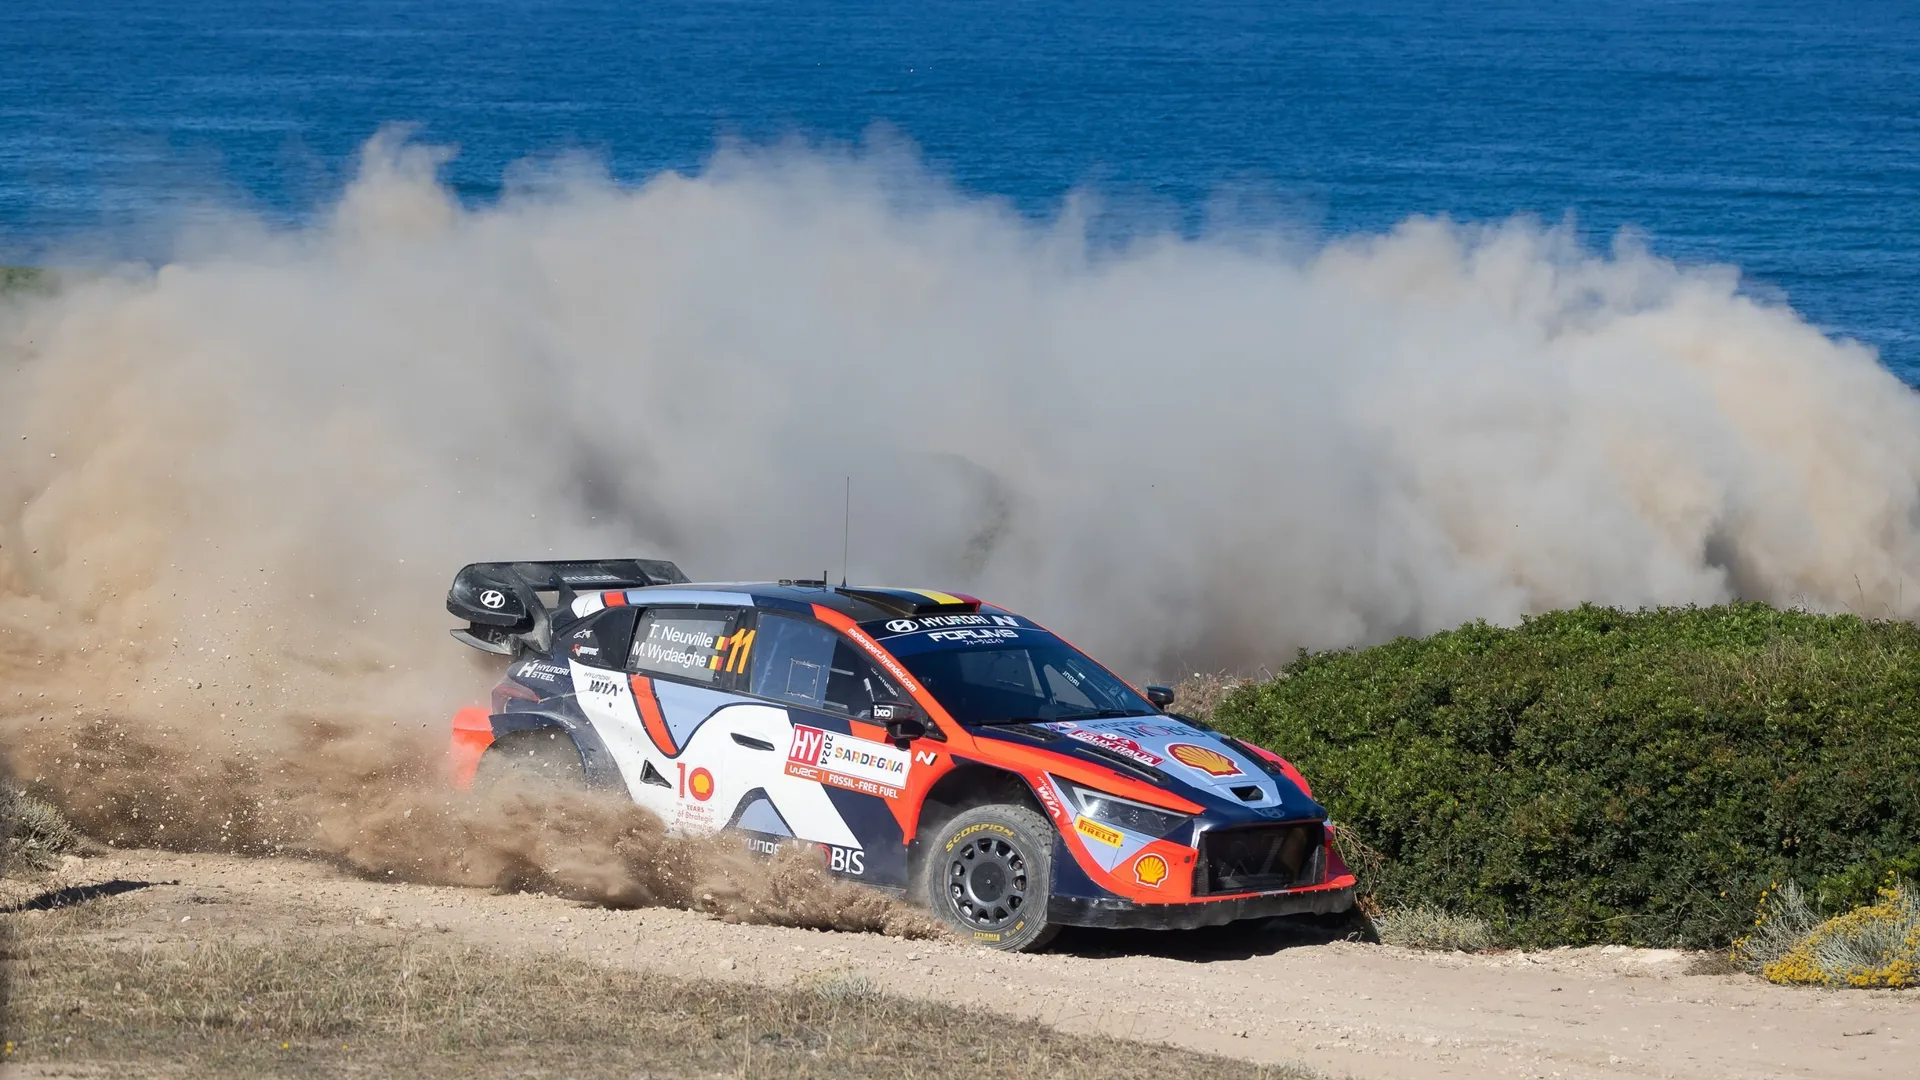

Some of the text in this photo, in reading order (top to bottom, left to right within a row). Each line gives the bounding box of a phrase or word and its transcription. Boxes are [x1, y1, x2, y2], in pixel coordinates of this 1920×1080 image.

[918, 615, 991, 627] HYUNDAI
[649, 623, 713, 648] T. Neuville
[927, 629, 1019, 642] FORUM8
[632, 641, 707, 668] M. Wydaeghe
[725, 628, 756, 674] 11
[847, 627, 917, 693] motorsport.hyundai.com
[531, 671, 556, 682] STEEL
[536, 663, 570, 676] HYUNDAI
[584, 671, 611, 680] HYUNDAI
[874, 705, 891, 719] ixo
[791, 729, 822, 762] HY
[820, 734, 834, 765] 2024
[1076, 732, 1115, 746] RALLY
[1116, 745, 1155, 763] ITALIA
[835, 747, 904, 774] SARDEGNA
[789, 764, 898, 799] WRC FOSSIL-FREE FUEL
[685, 811, 713, 824] Strategic
[687, 804, 704, 813] YEARS
[945, 823, 1015, 852] SCORPION
[1078, 819, 1119, 844] PIRELLI
